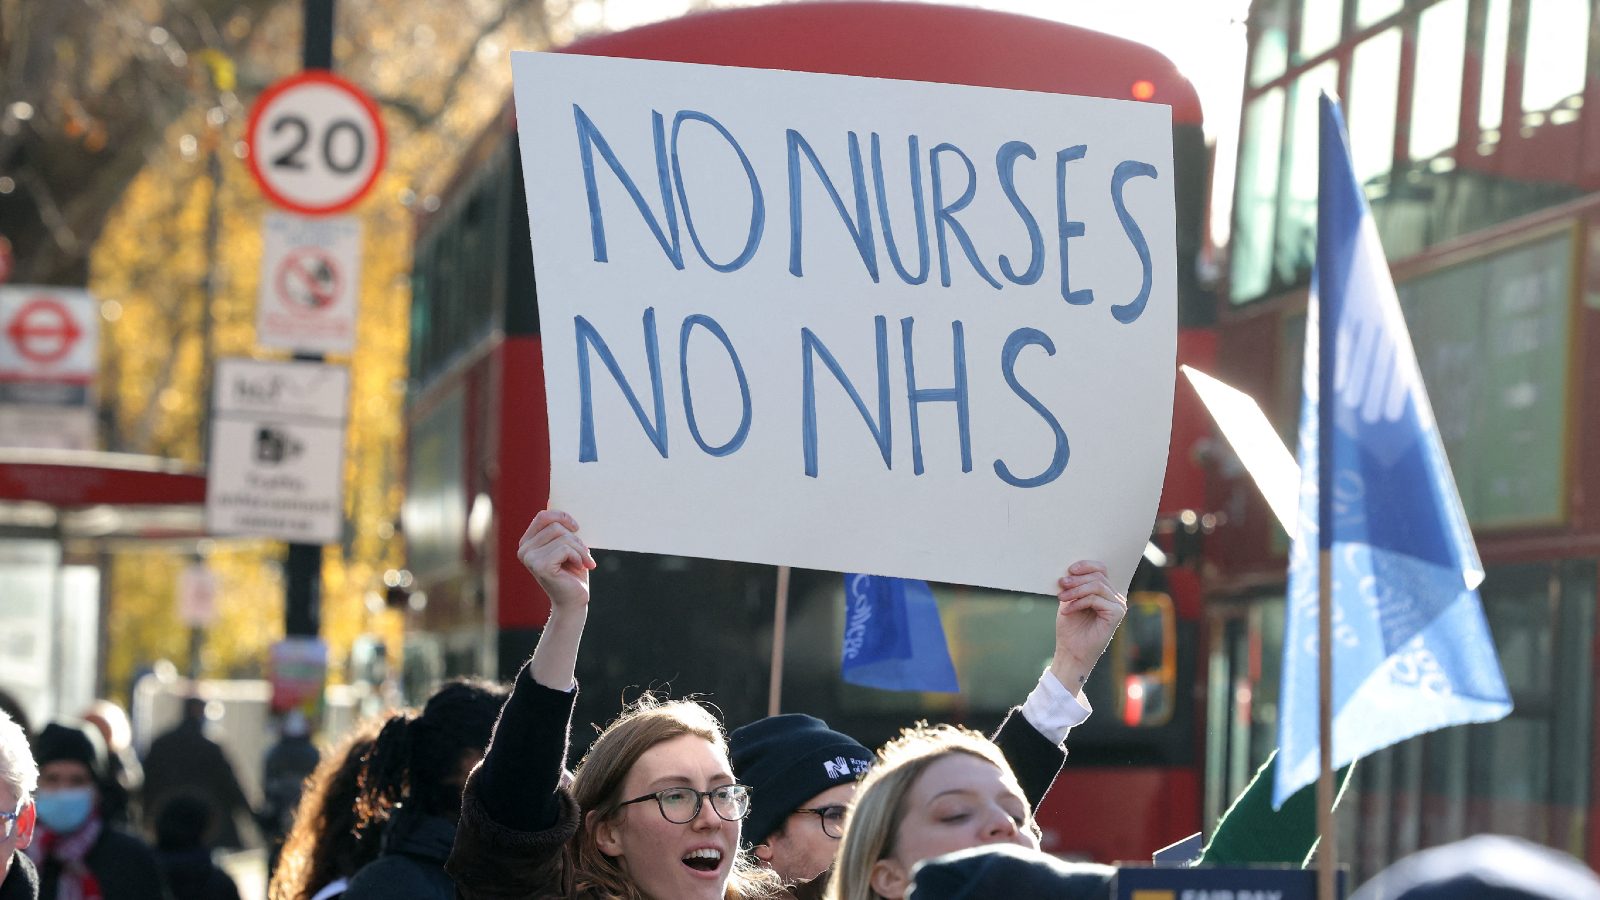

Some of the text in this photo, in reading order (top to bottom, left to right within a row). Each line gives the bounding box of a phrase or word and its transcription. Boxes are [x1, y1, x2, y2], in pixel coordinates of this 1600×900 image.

[271, 115, 365, 174] 20
[572, 103, 1158, 324] NO NURSES
[573, 306, 1070, 488] NO NHS
